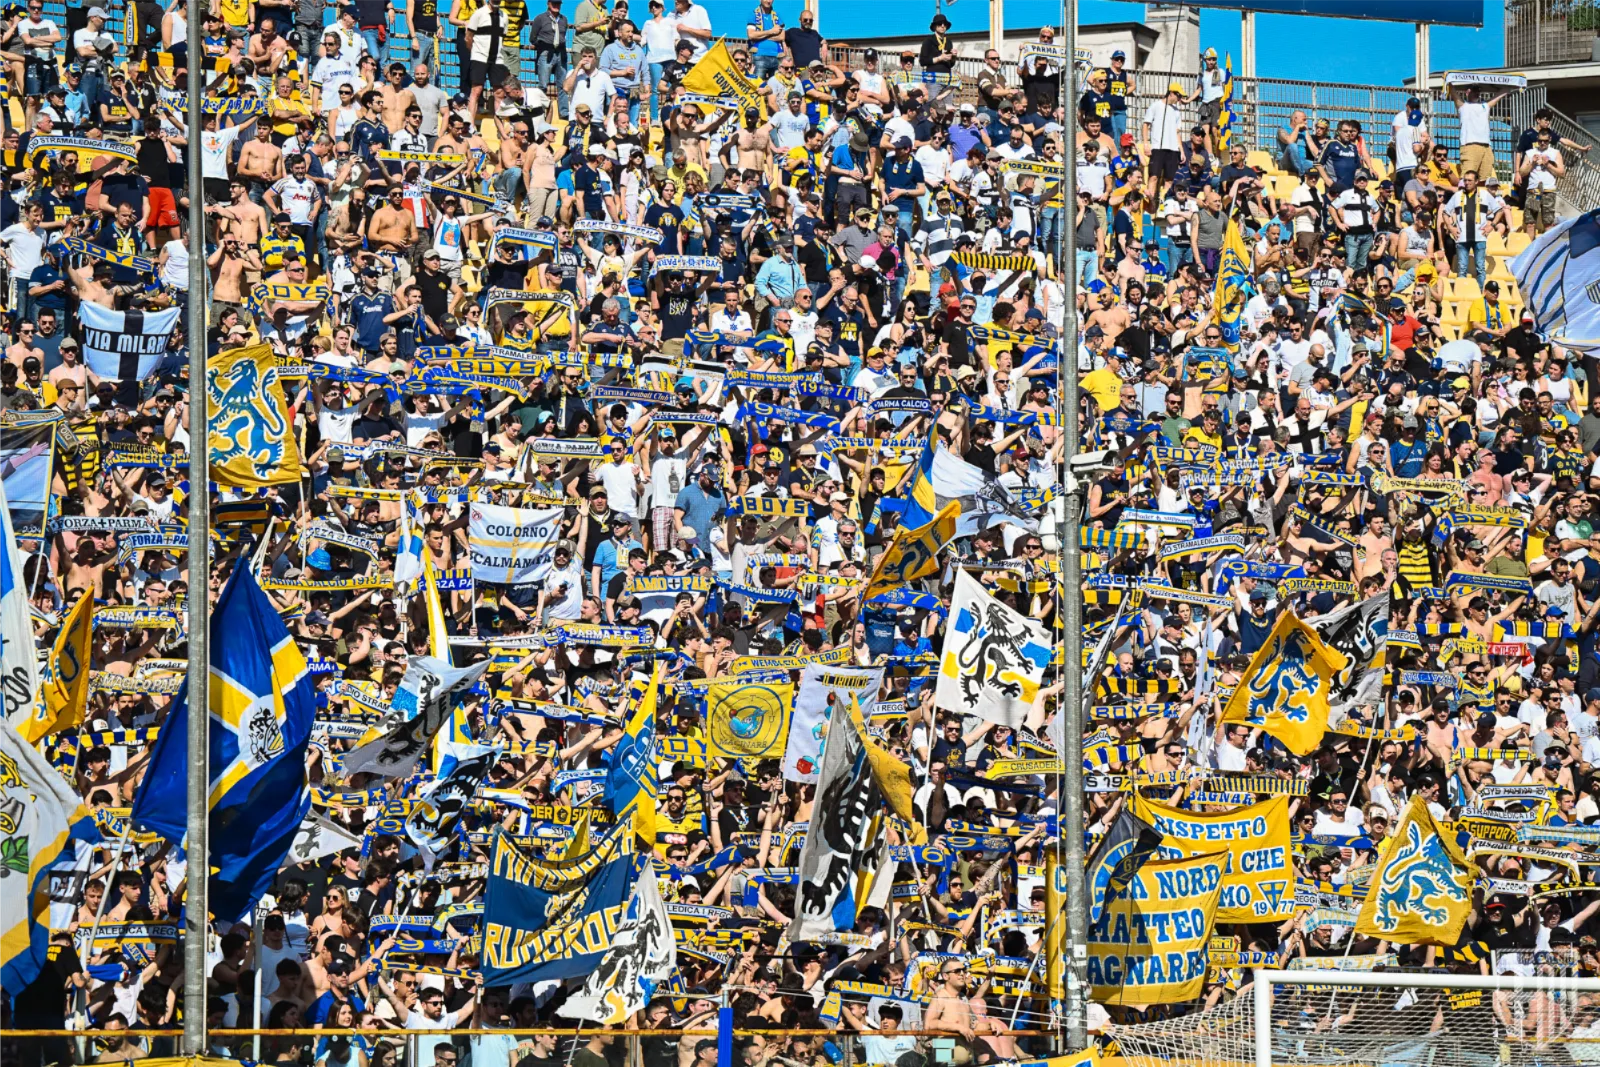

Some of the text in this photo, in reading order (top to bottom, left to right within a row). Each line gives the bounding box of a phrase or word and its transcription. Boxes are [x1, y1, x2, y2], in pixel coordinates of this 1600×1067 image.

[1483, 75, 1510, 84] CALCIO
[217, 98, 265, 111] PARMA
[398, 153, 443, 162] BOYS
[69, 237, 152, 271] BOYS
[253, 283, 330, 299] BOYS
[85, 327, 110, 351] VIA
[972, 326, 1054, 348] BOYS
[419, 345, 492, 359] BOYS
[457, 361, 538, 376] BOYS
[597, 387, 670, 401] Parma Football Club
[801, 382, 817, 394] 19
[835, 385, 853, 398] 77
[901, 399, 929, 409] CALCIO
[881, 438, 928, 448] BAGNA
[1156, 446, 1216, 462] BOYS
[1183, 473, 1217, 487] PARMA
[747, 497, 806, 515] BOYS
[107, 517, 149, 529] PARMA
[486, 524, 548, 539] COLORNO
[131, 535, 163, 547] FORZA
[263, 576, 301, 588] PARMA
[305, 577, 348, 588] CALCIO
[417, 578, 455, 590] FRZA
[816, 575, 854, 587] BOY
[1100, 573, 1161, 586] BOYS
[1324, 580, 1355, 591] PARM
[99, 610, 171, 623] PARMA F.C.
[569, 628, 635, 640] PARMA F.C.
[308, 662, 332, 672] ARMA
[102, 676, 151, 690] MAGICO
[881, 703, 904, 712] REGG
[1095, 704, 1160, 720] BOYS
[1010, 760, 1062, 772] CRUSADERS
[1188, 790, 1254, 806] BAGNAR
[1153, 815, 1267, 842] RISPETTO
[1240, 847, 1286, 873] CHE
[1155, 864, 1222, 901] NORD
[1294, 895, 1318, 904] REGGI
[666, 904, 700, 915] LEDICA
[1253, 899, 1295, 915] 19 77
[1087, 907, 1205, 944] MATTEO
